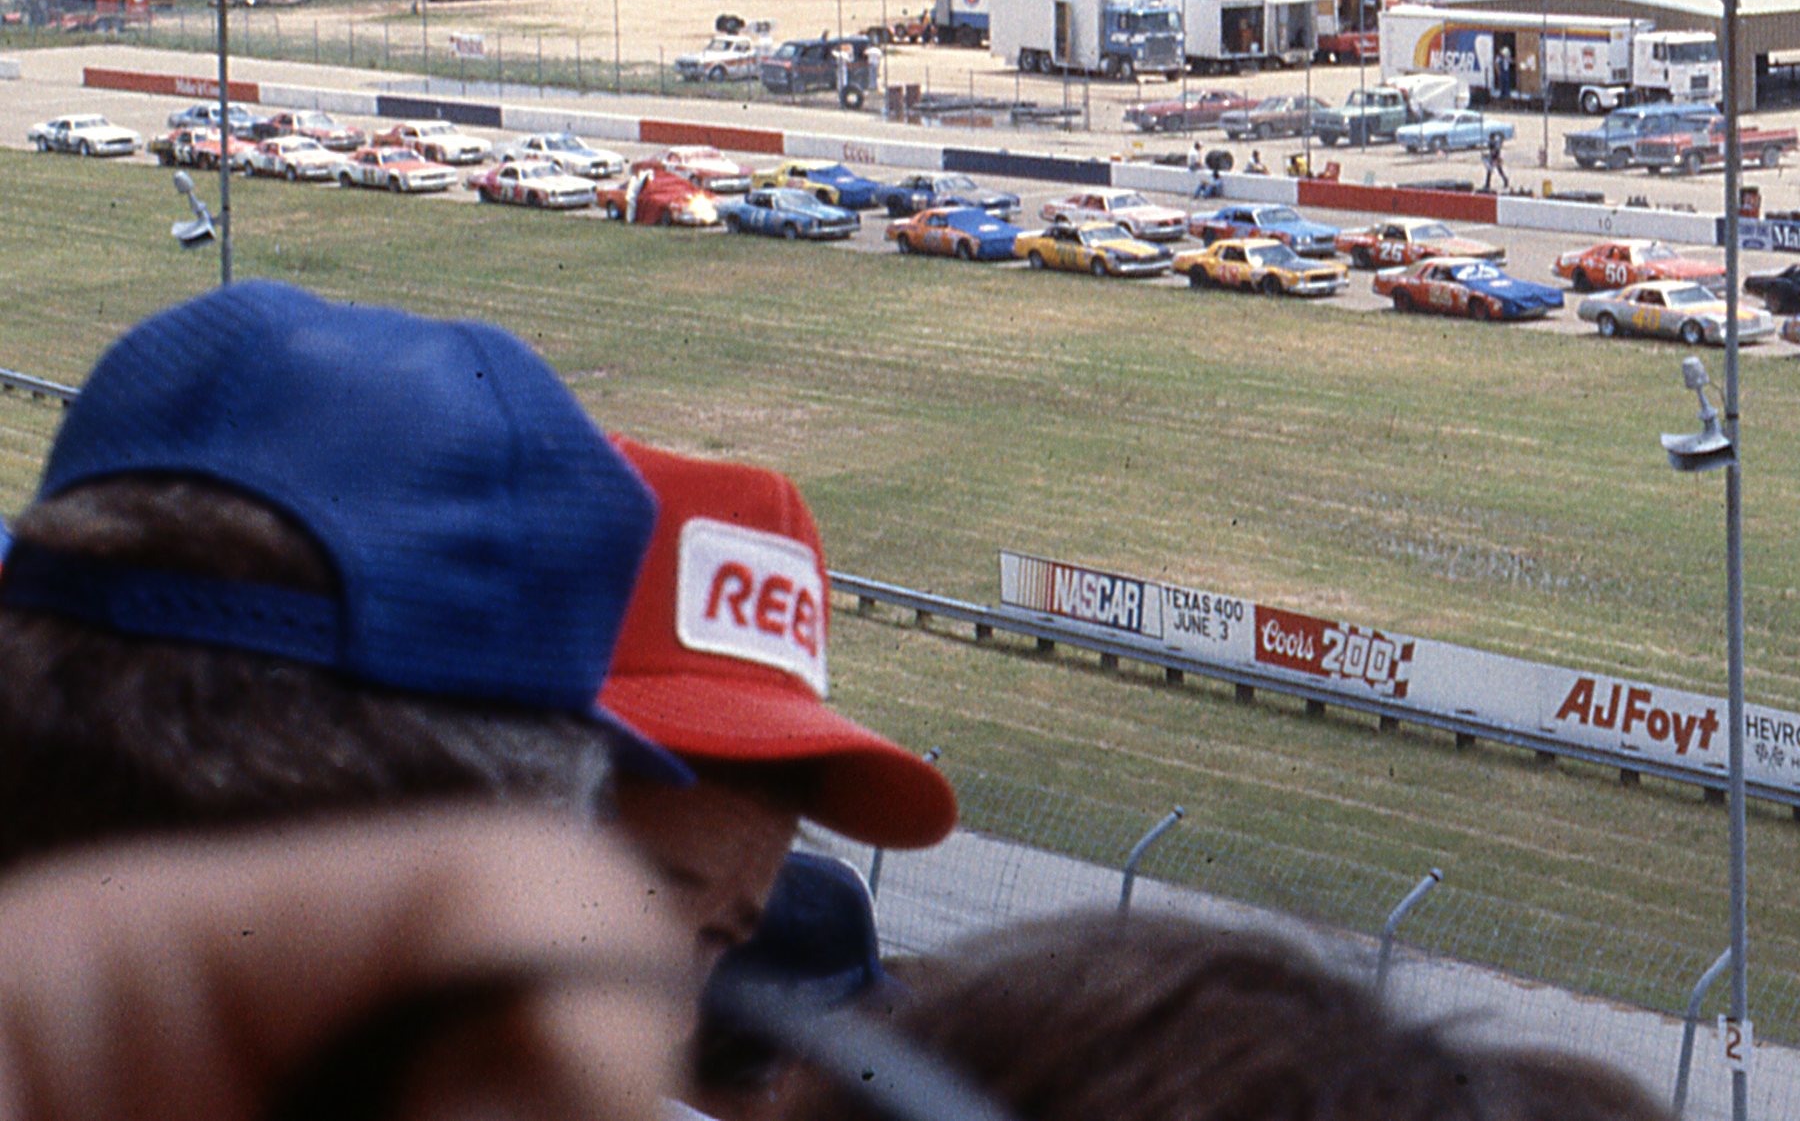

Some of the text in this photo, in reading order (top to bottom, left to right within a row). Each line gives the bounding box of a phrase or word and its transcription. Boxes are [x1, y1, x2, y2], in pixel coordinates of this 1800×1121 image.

[1604, 266, 1628, 284] 50
[1053, 566, 1140, 631] NASCAR
[1164, 586, 1244, 622] TEXAS 400
[1173, 611, 1229, 641] JUNE 3
[1261, 619, 1397, 678] Coors 200
[1725, 1025, 1742, 1061] 2
